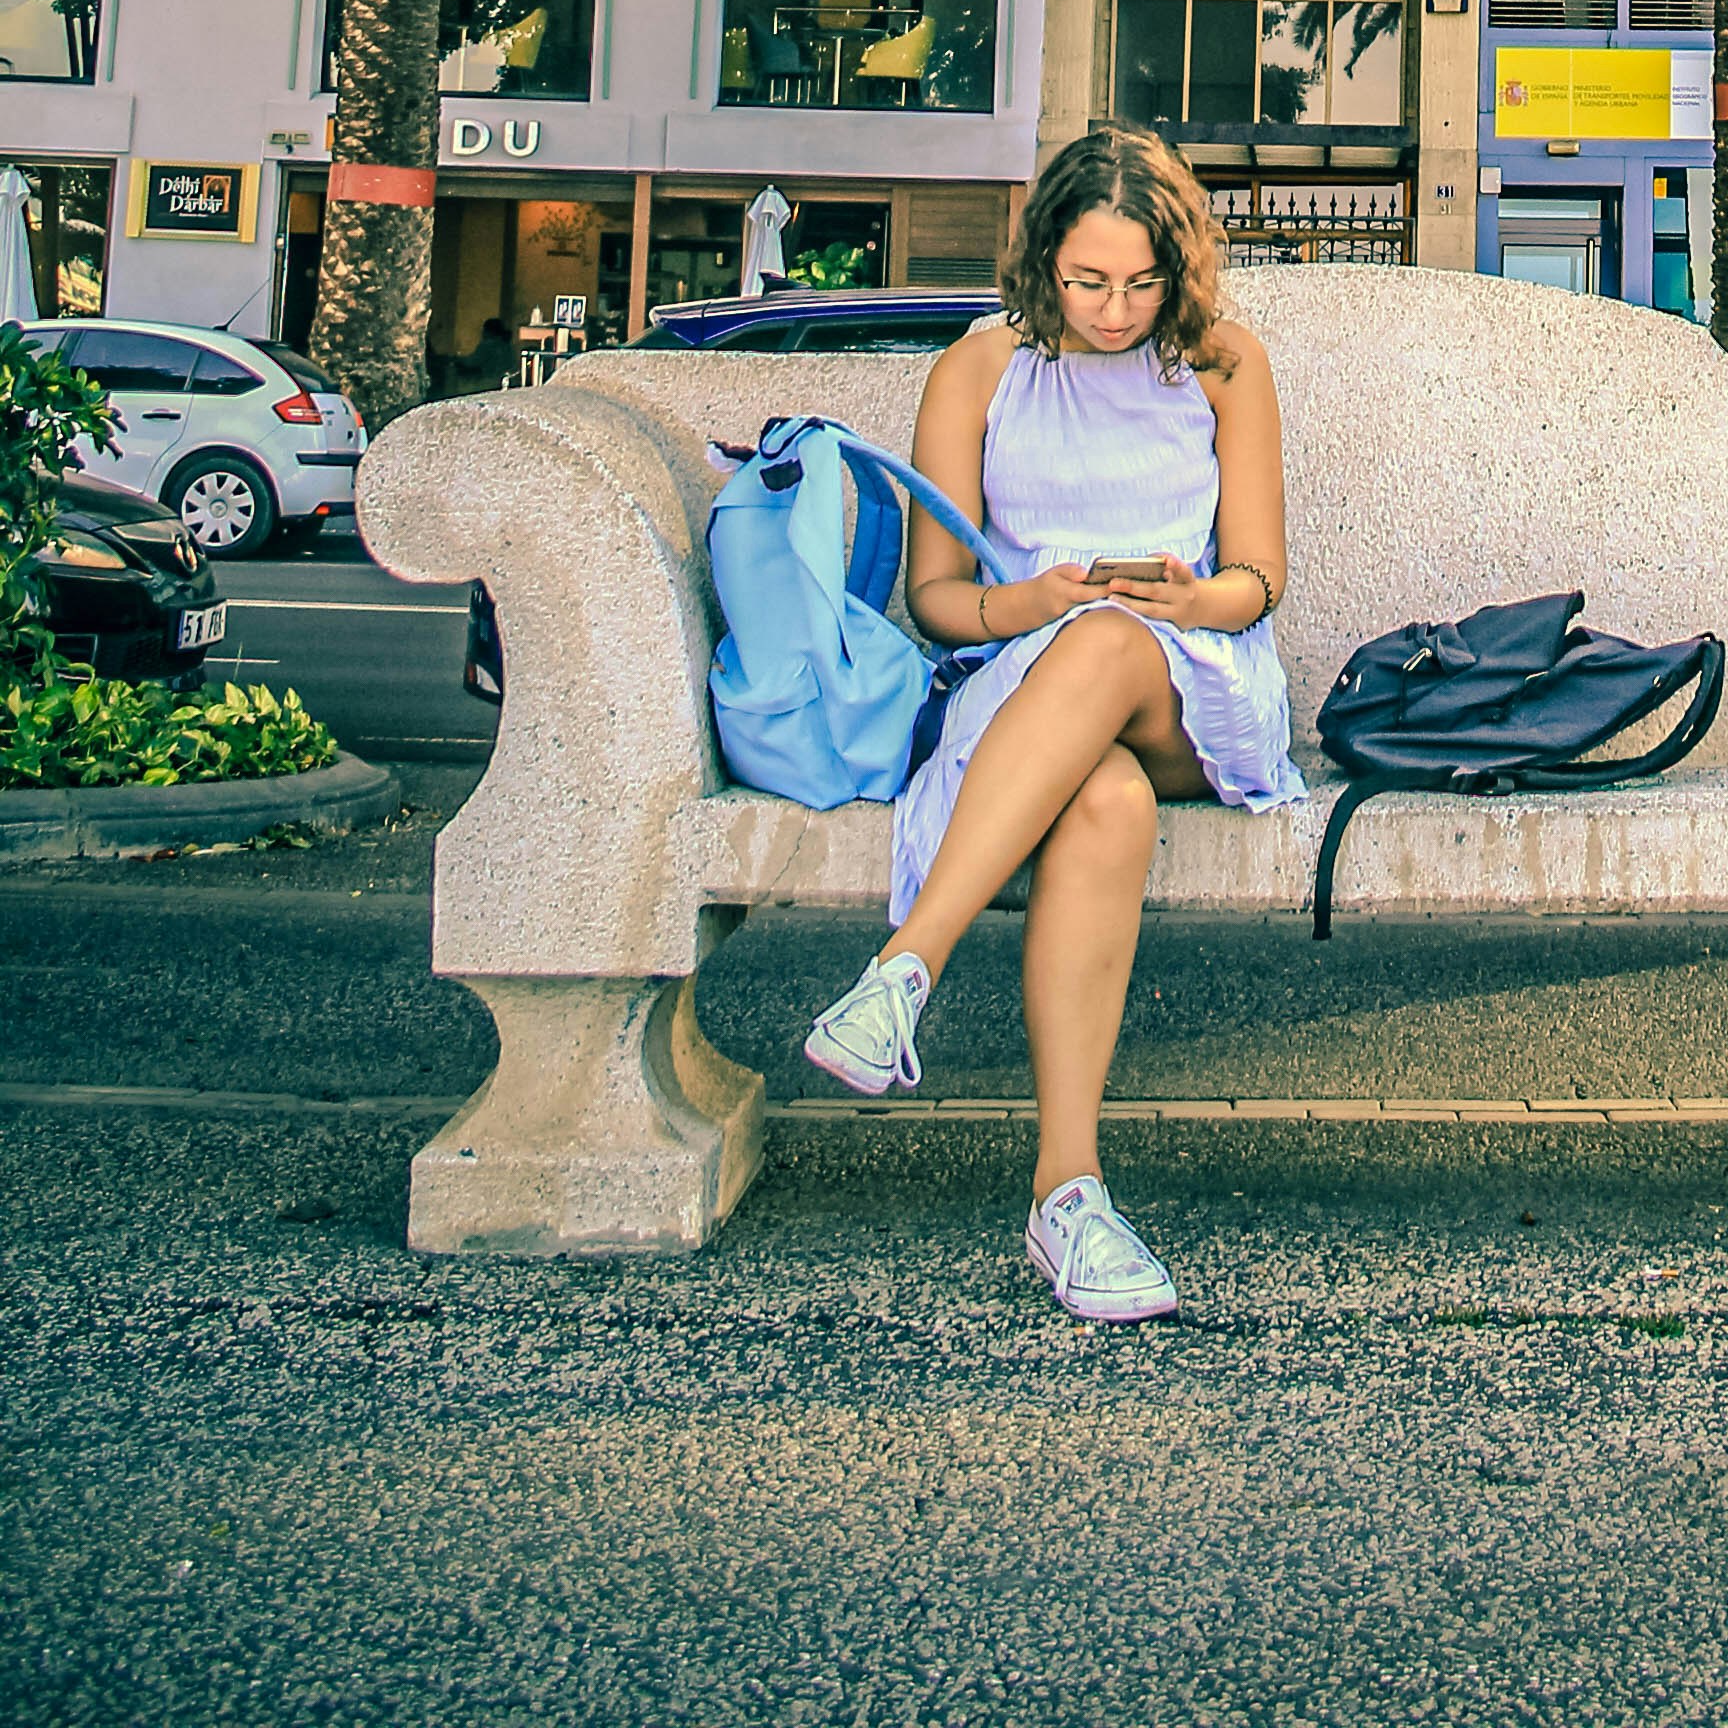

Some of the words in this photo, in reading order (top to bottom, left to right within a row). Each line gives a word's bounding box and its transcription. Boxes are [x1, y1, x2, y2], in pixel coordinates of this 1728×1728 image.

[451, 118, 541, 158] DU
[1437, 185, 1454, 198] 31
[170, 194, 223, 213] Darbar
